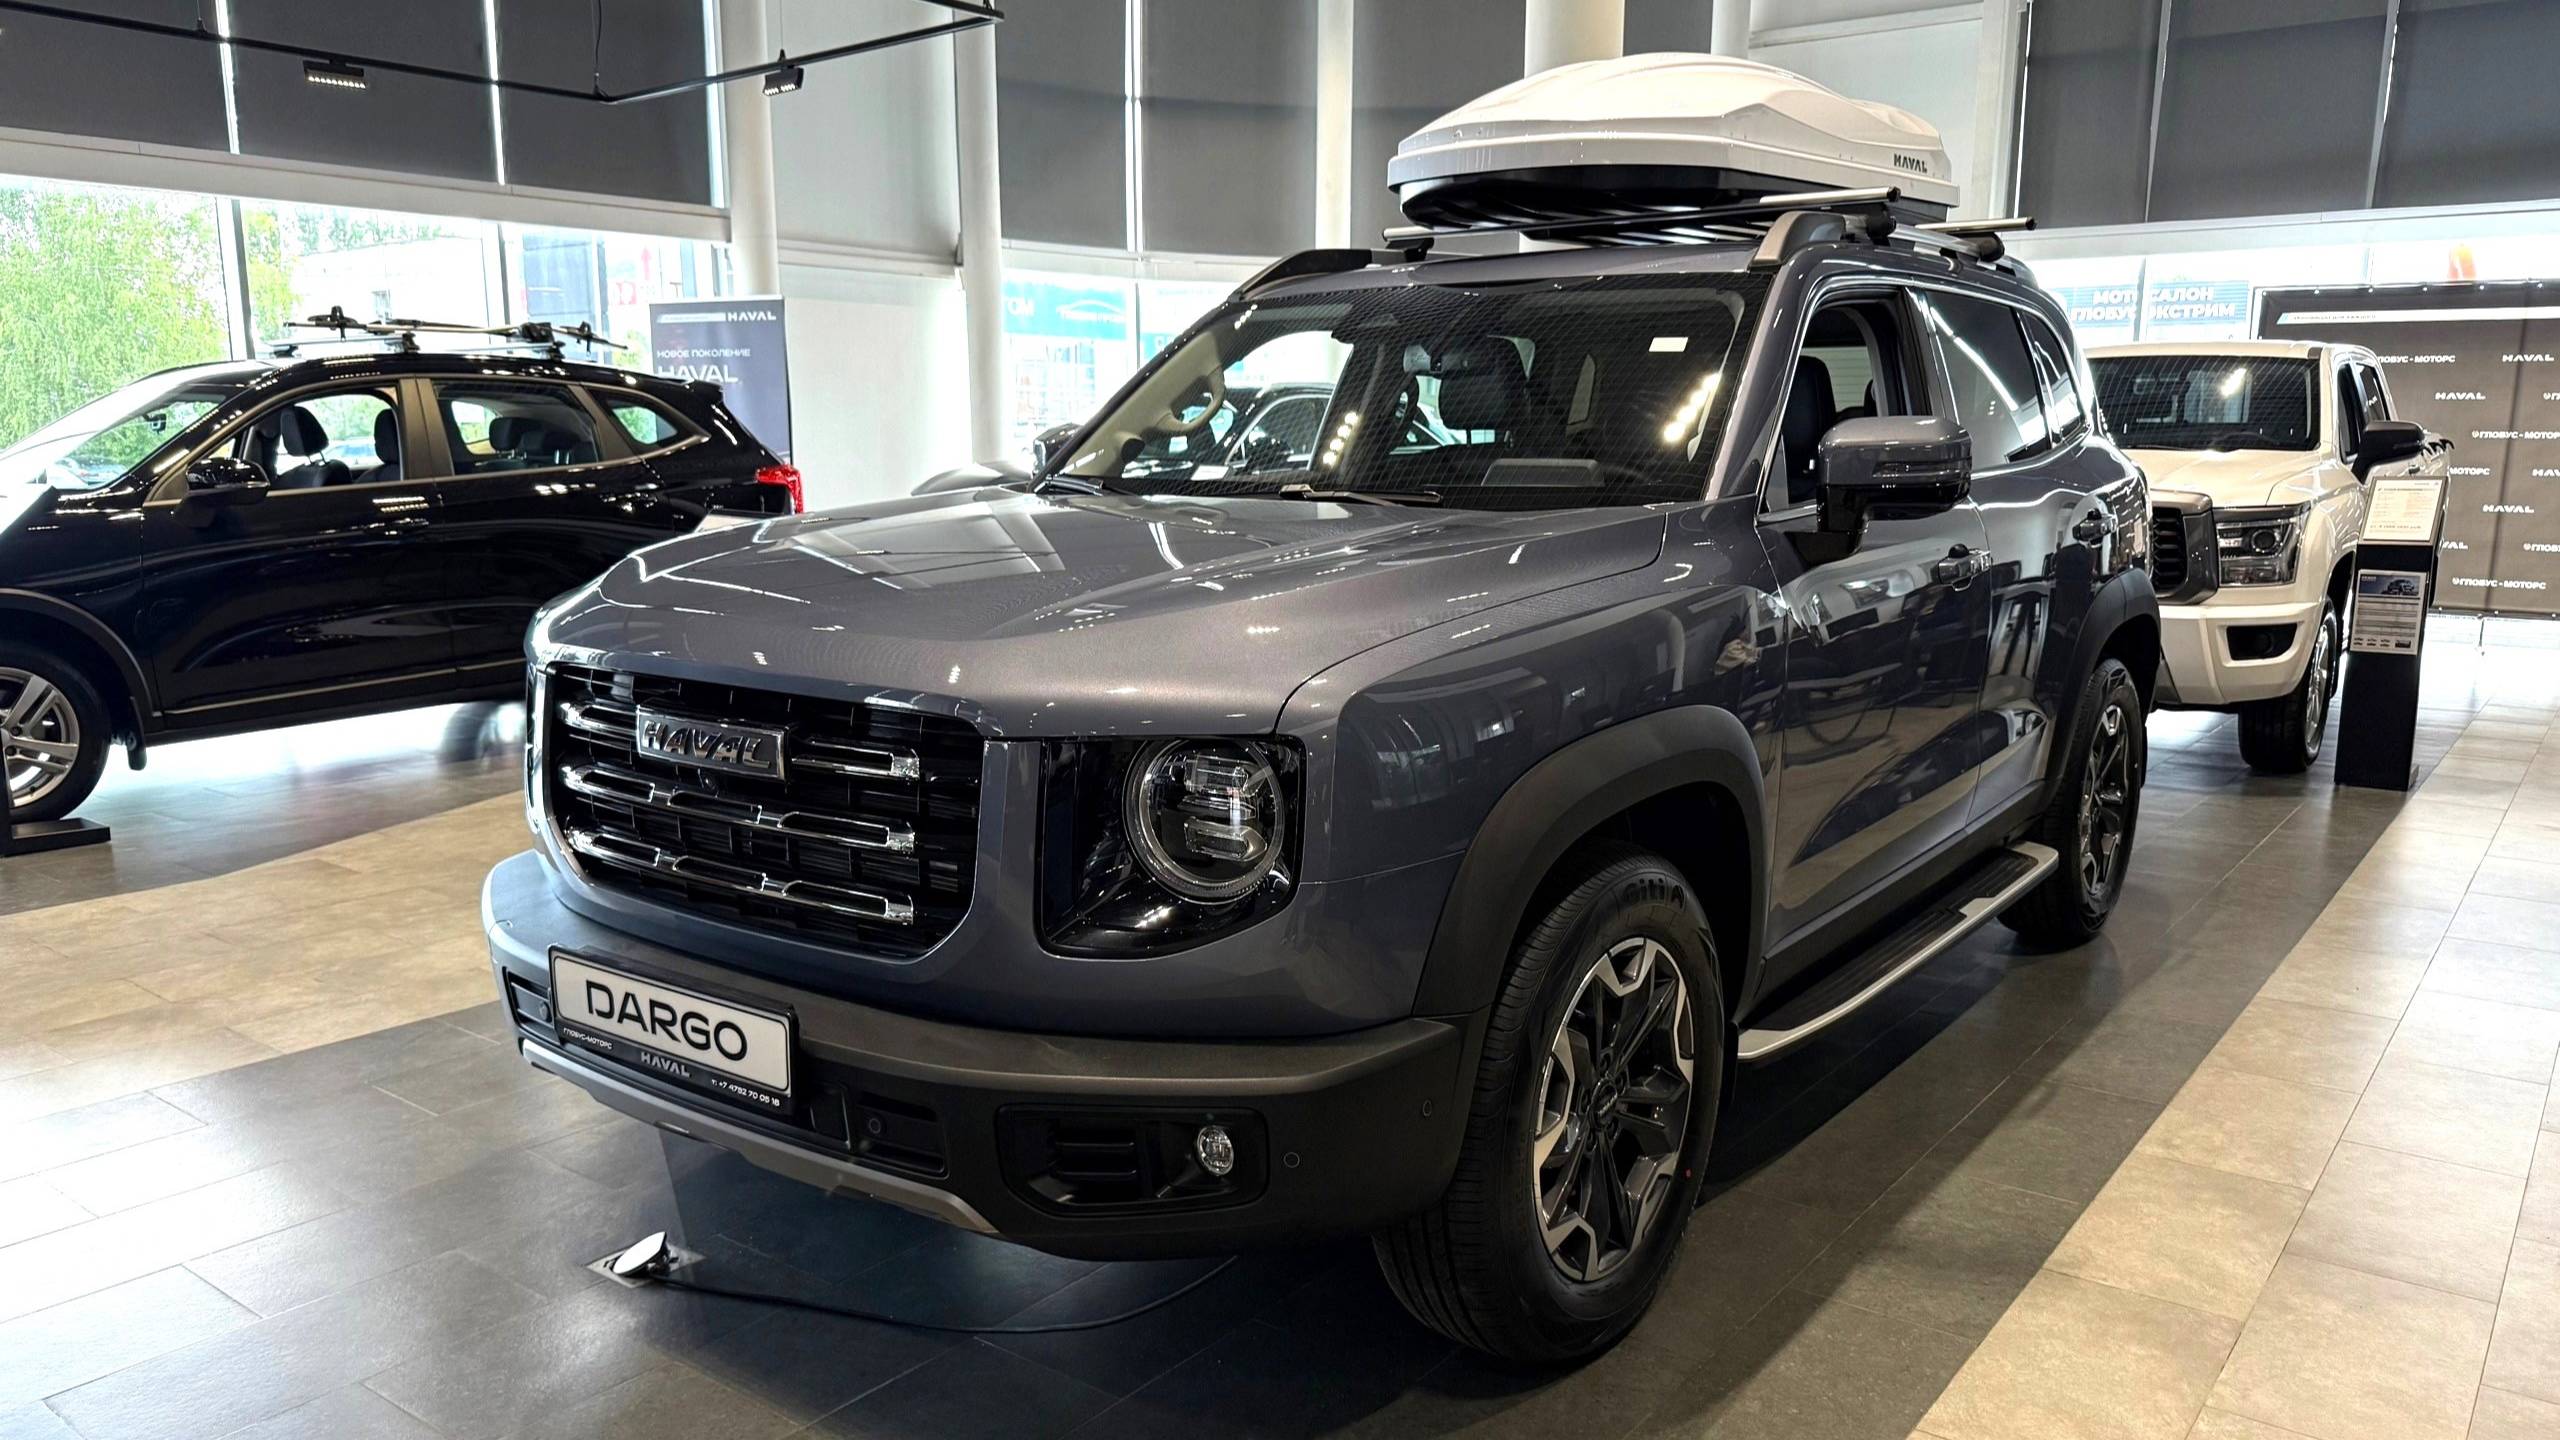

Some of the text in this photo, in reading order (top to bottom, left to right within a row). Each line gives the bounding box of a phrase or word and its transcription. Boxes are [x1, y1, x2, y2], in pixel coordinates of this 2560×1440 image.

[1893, 152, 1928, 174] HAVAL
[727, 311, 777, 322] HAVAL
[657, 348, 751, 359] НОВОЕ ПОКОЛЕНИЕ
[2502, 354, 2555, 362] HAVAL
[2378, 355, 2409, 364] ЛОБУС
[2414, 355, 2456, 363] МОТОРС
[657, 364, 739, 384] HAVAL
[2435, 392, 2486, 400] HAVAL
[2482, 505, 2535, 513] HAVAL
[2503, 580, 2546, 589] МОТОРС
[642, 720, 771, 769] HAVAL
[586, 979, 748, 1062] DARGO
[641, 1051, 690, 1078] HAVAL
[748, 1090, 758, 1100] 70
